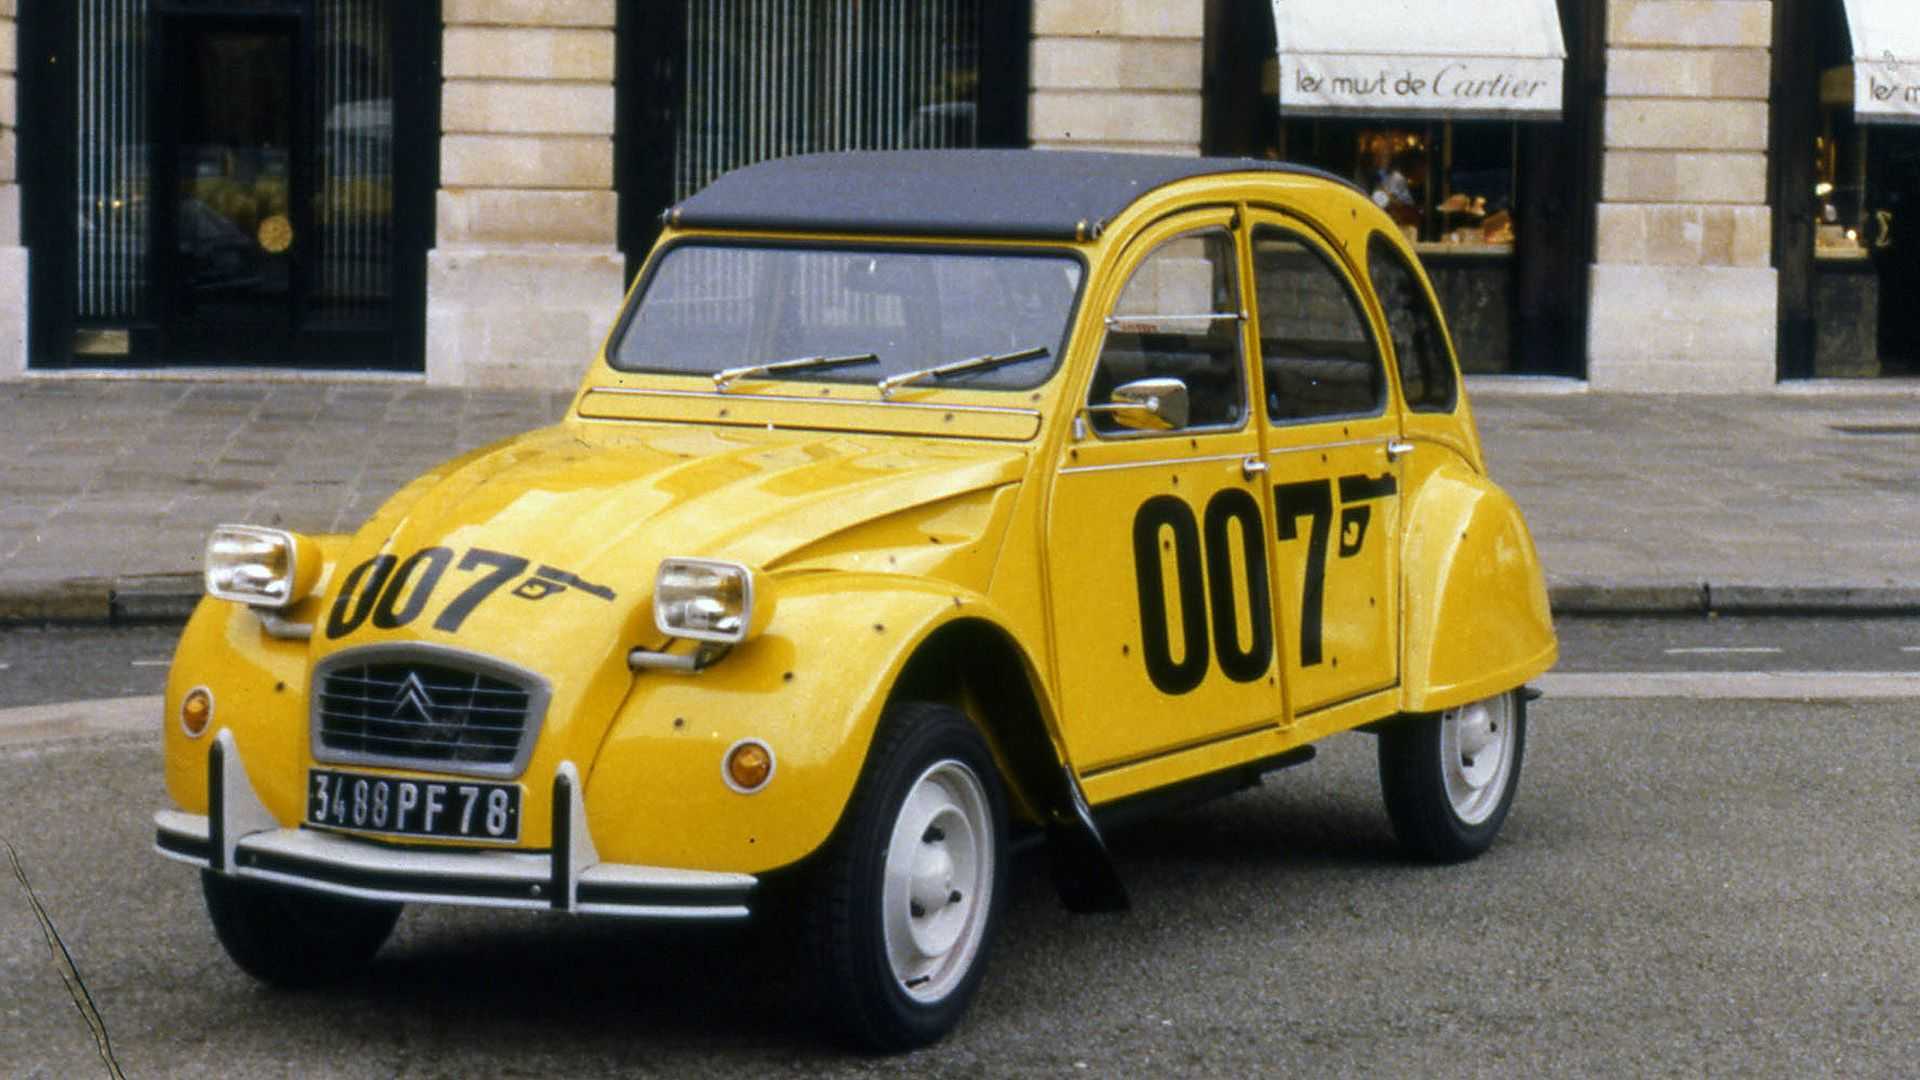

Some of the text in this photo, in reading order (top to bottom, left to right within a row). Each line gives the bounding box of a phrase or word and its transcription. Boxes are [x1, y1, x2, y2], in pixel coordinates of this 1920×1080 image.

[1295, 64, 1547, 97] les must de Cartier
[1868, 76, 1899, 101] les
[326, 546, 529, 640] 007
[1133, 479, 1333, 696] 007
